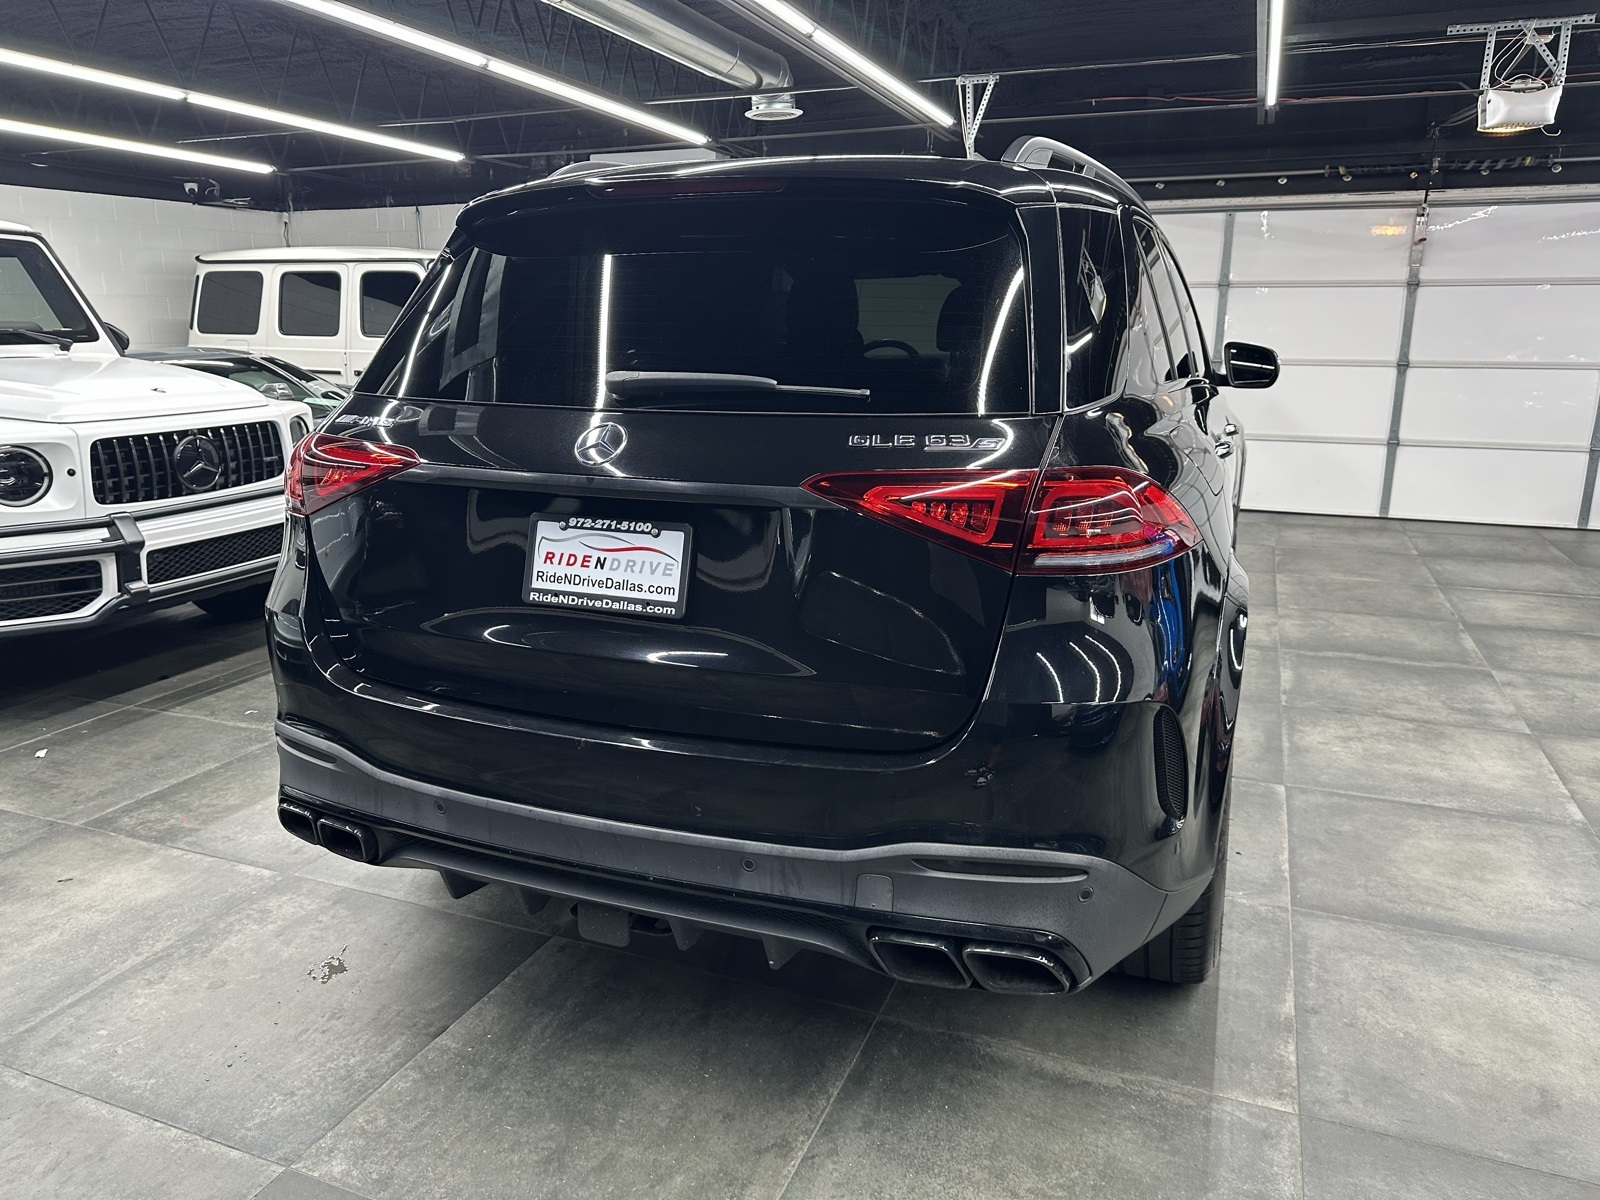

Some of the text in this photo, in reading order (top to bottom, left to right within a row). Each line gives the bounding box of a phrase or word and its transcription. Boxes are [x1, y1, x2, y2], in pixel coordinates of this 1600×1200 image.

[848, 434, 916, 448] GLE
[569, 517, 653, 532] 972-271-5100
[536, 570, 675, 596] RideNDriveDallas.com
[529, 592, 676, 615] RideNDriveDallas.com
